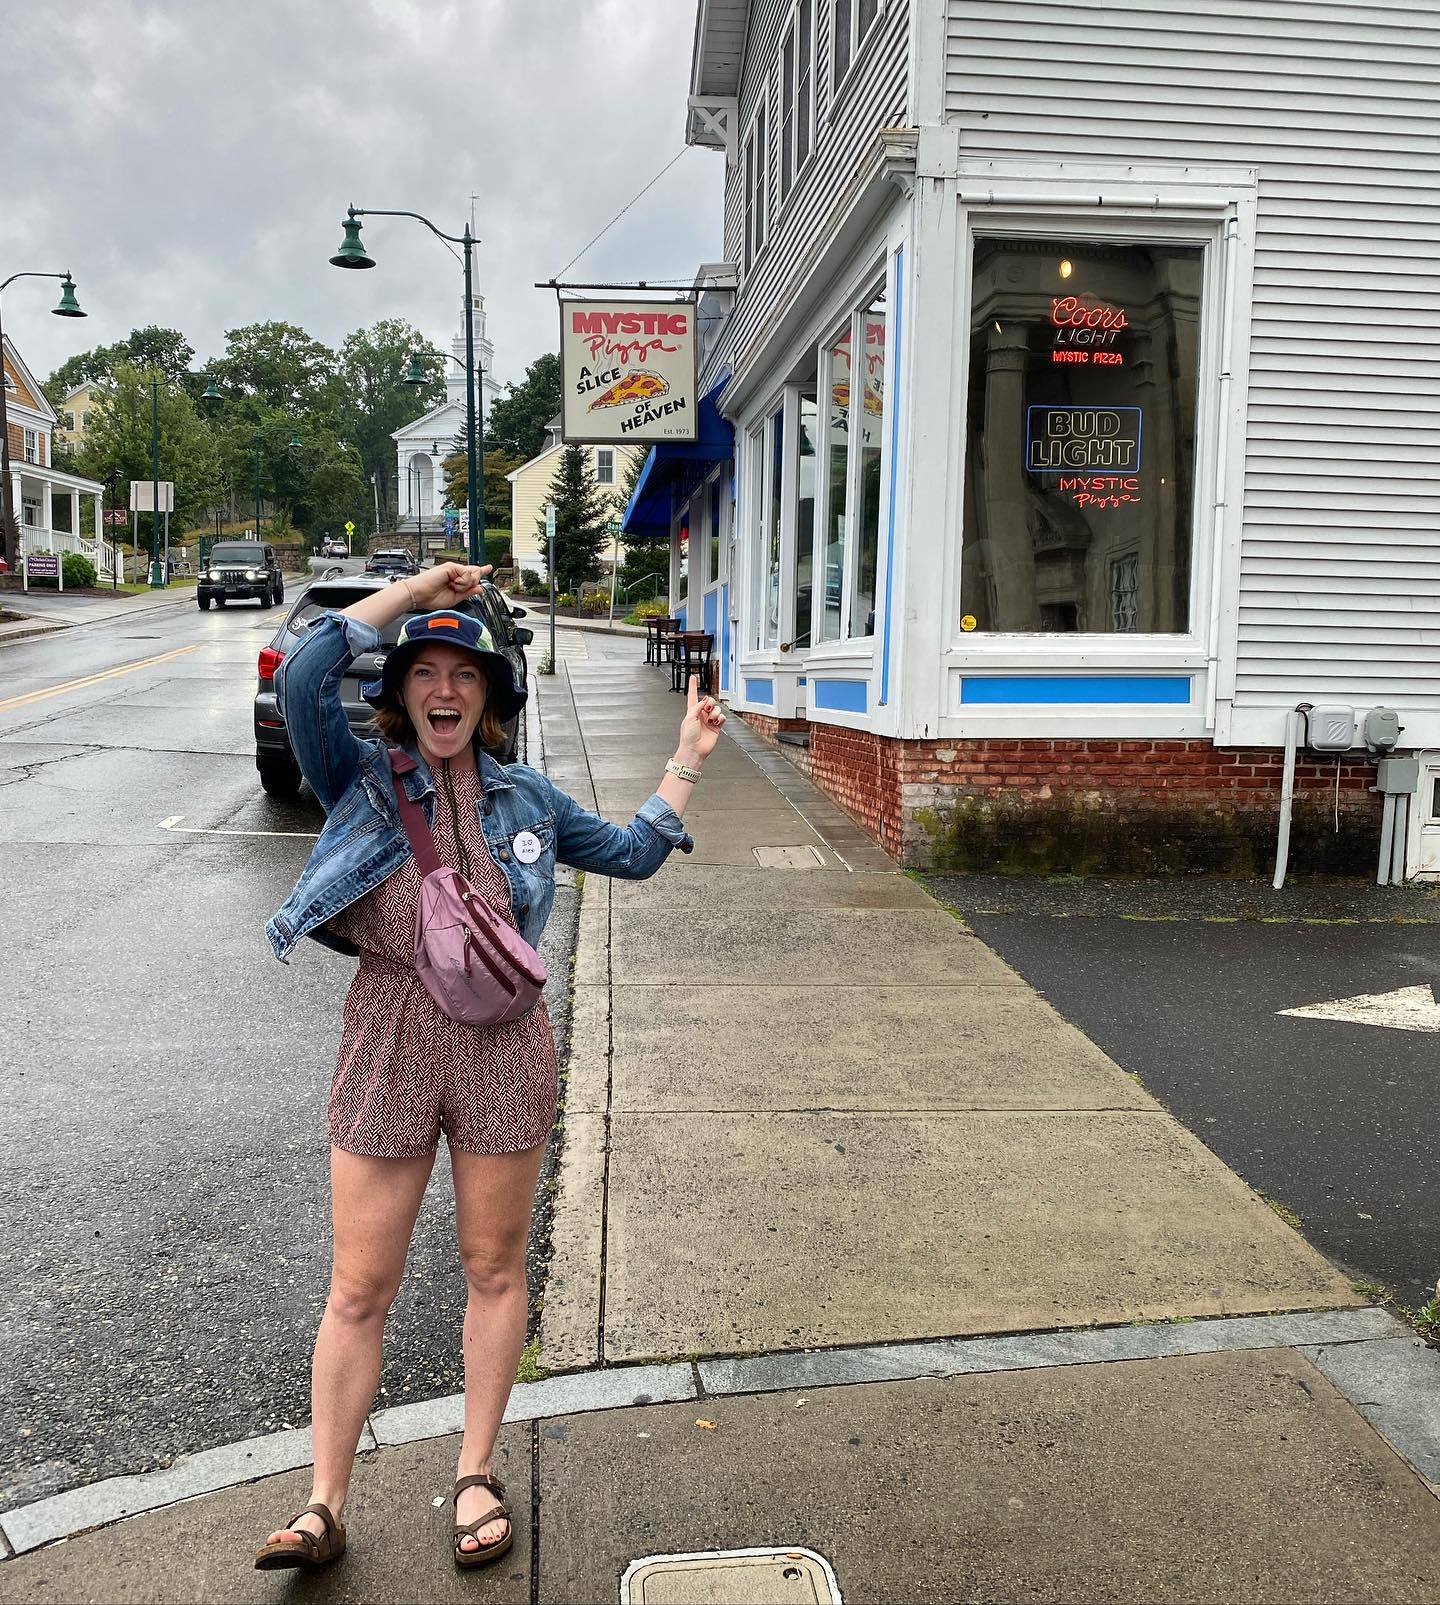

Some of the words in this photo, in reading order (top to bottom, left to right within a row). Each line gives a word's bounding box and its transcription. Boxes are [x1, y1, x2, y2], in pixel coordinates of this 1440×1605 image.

[572, 312, 687, 335] MYSTIC
[1052, 296, 1128, 328] Coors
[1056, 329, 1121, 344] LIGHT
[583, 335, 677, 365] Pizza
[1053, 350, 1088, 363] MYSTIC
[1093, 352, 1123, 364] PIZZA
[576, 367, 622, 395] SLICE
[579, 366, 592, 380] A
[620, 397, 687, 433] HEAVEN
[635, 402, 651, 414] OF
[1048, 411, 1121, 437] BUD
[1031, 439, 1135, 467] LIGHT
[1060, 477, 1140, 491] MYSTIC
[1072, 493, 1141, 508] Pizza
